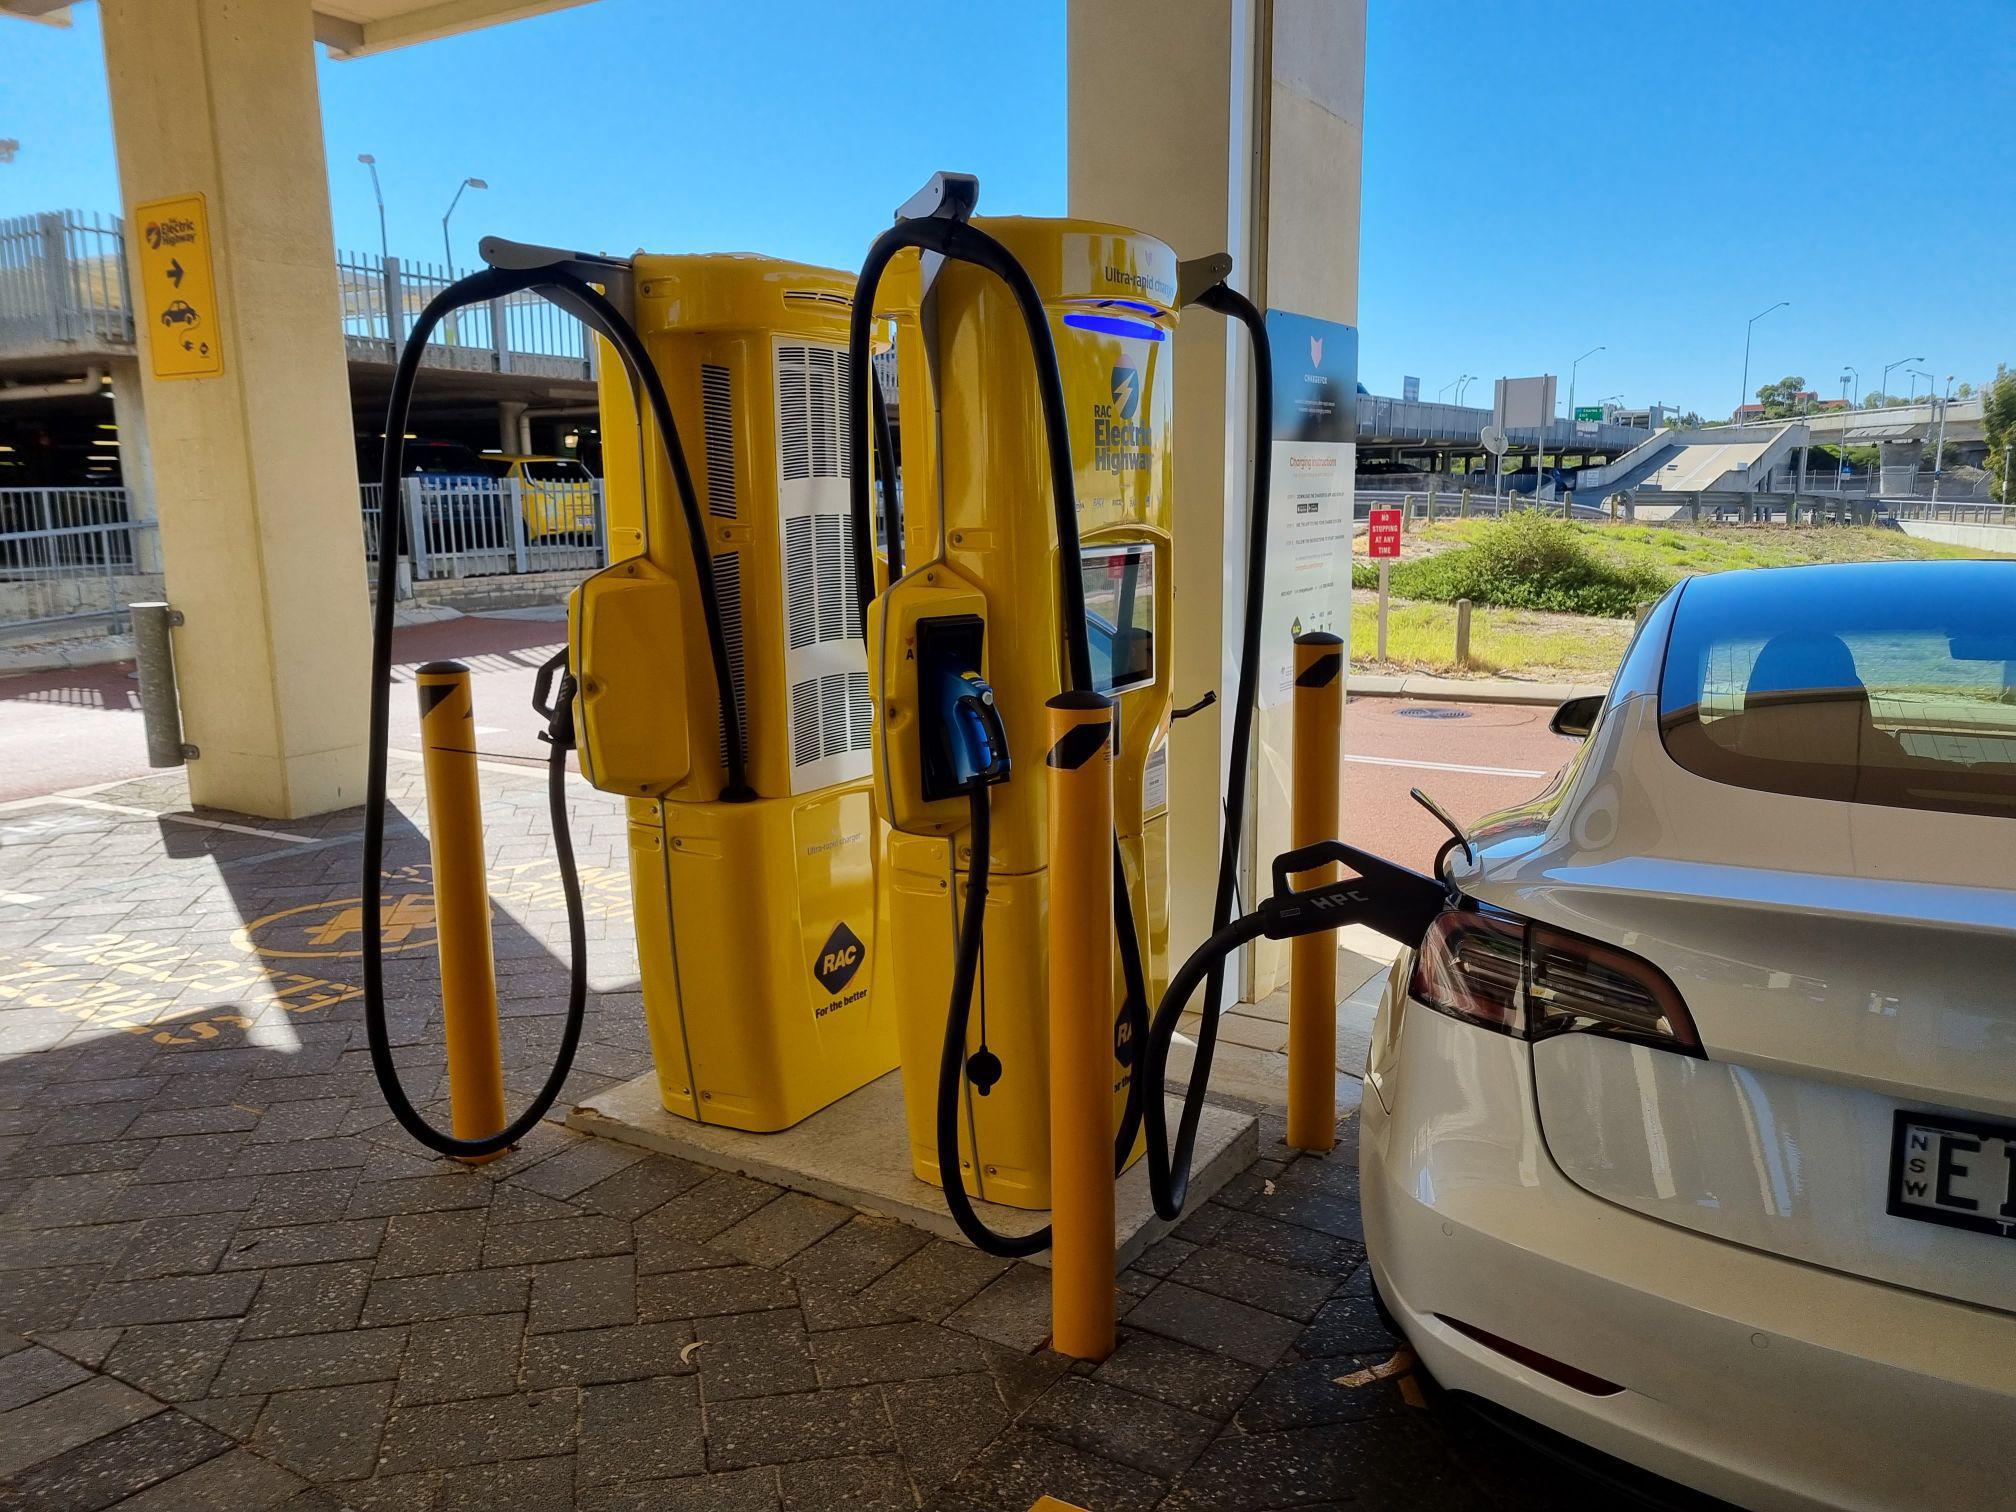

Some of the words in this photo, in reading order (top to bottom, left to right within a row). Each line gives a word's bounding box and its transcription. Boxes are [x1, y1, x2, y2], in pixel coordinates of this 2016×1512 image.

[1094, 405, 1112, 417] RAC
[1381, 513, 1390, 522] NO
[1372, 524, 1399, 533] STOPPING
[1375, 535, 1382, 544] AT
[1383, 535, 1395, 544] ANY
[1378, 546, 1391, 554] TIME
[906, 649, 914, 660] A
[1310, 890, 1369, 910] HPC
[823, 945, 857, 975] RAC
[815, 1006, 829, 1019] For
[830, 999, 843, 1012] the
[843, 988, 867, 1007] better
